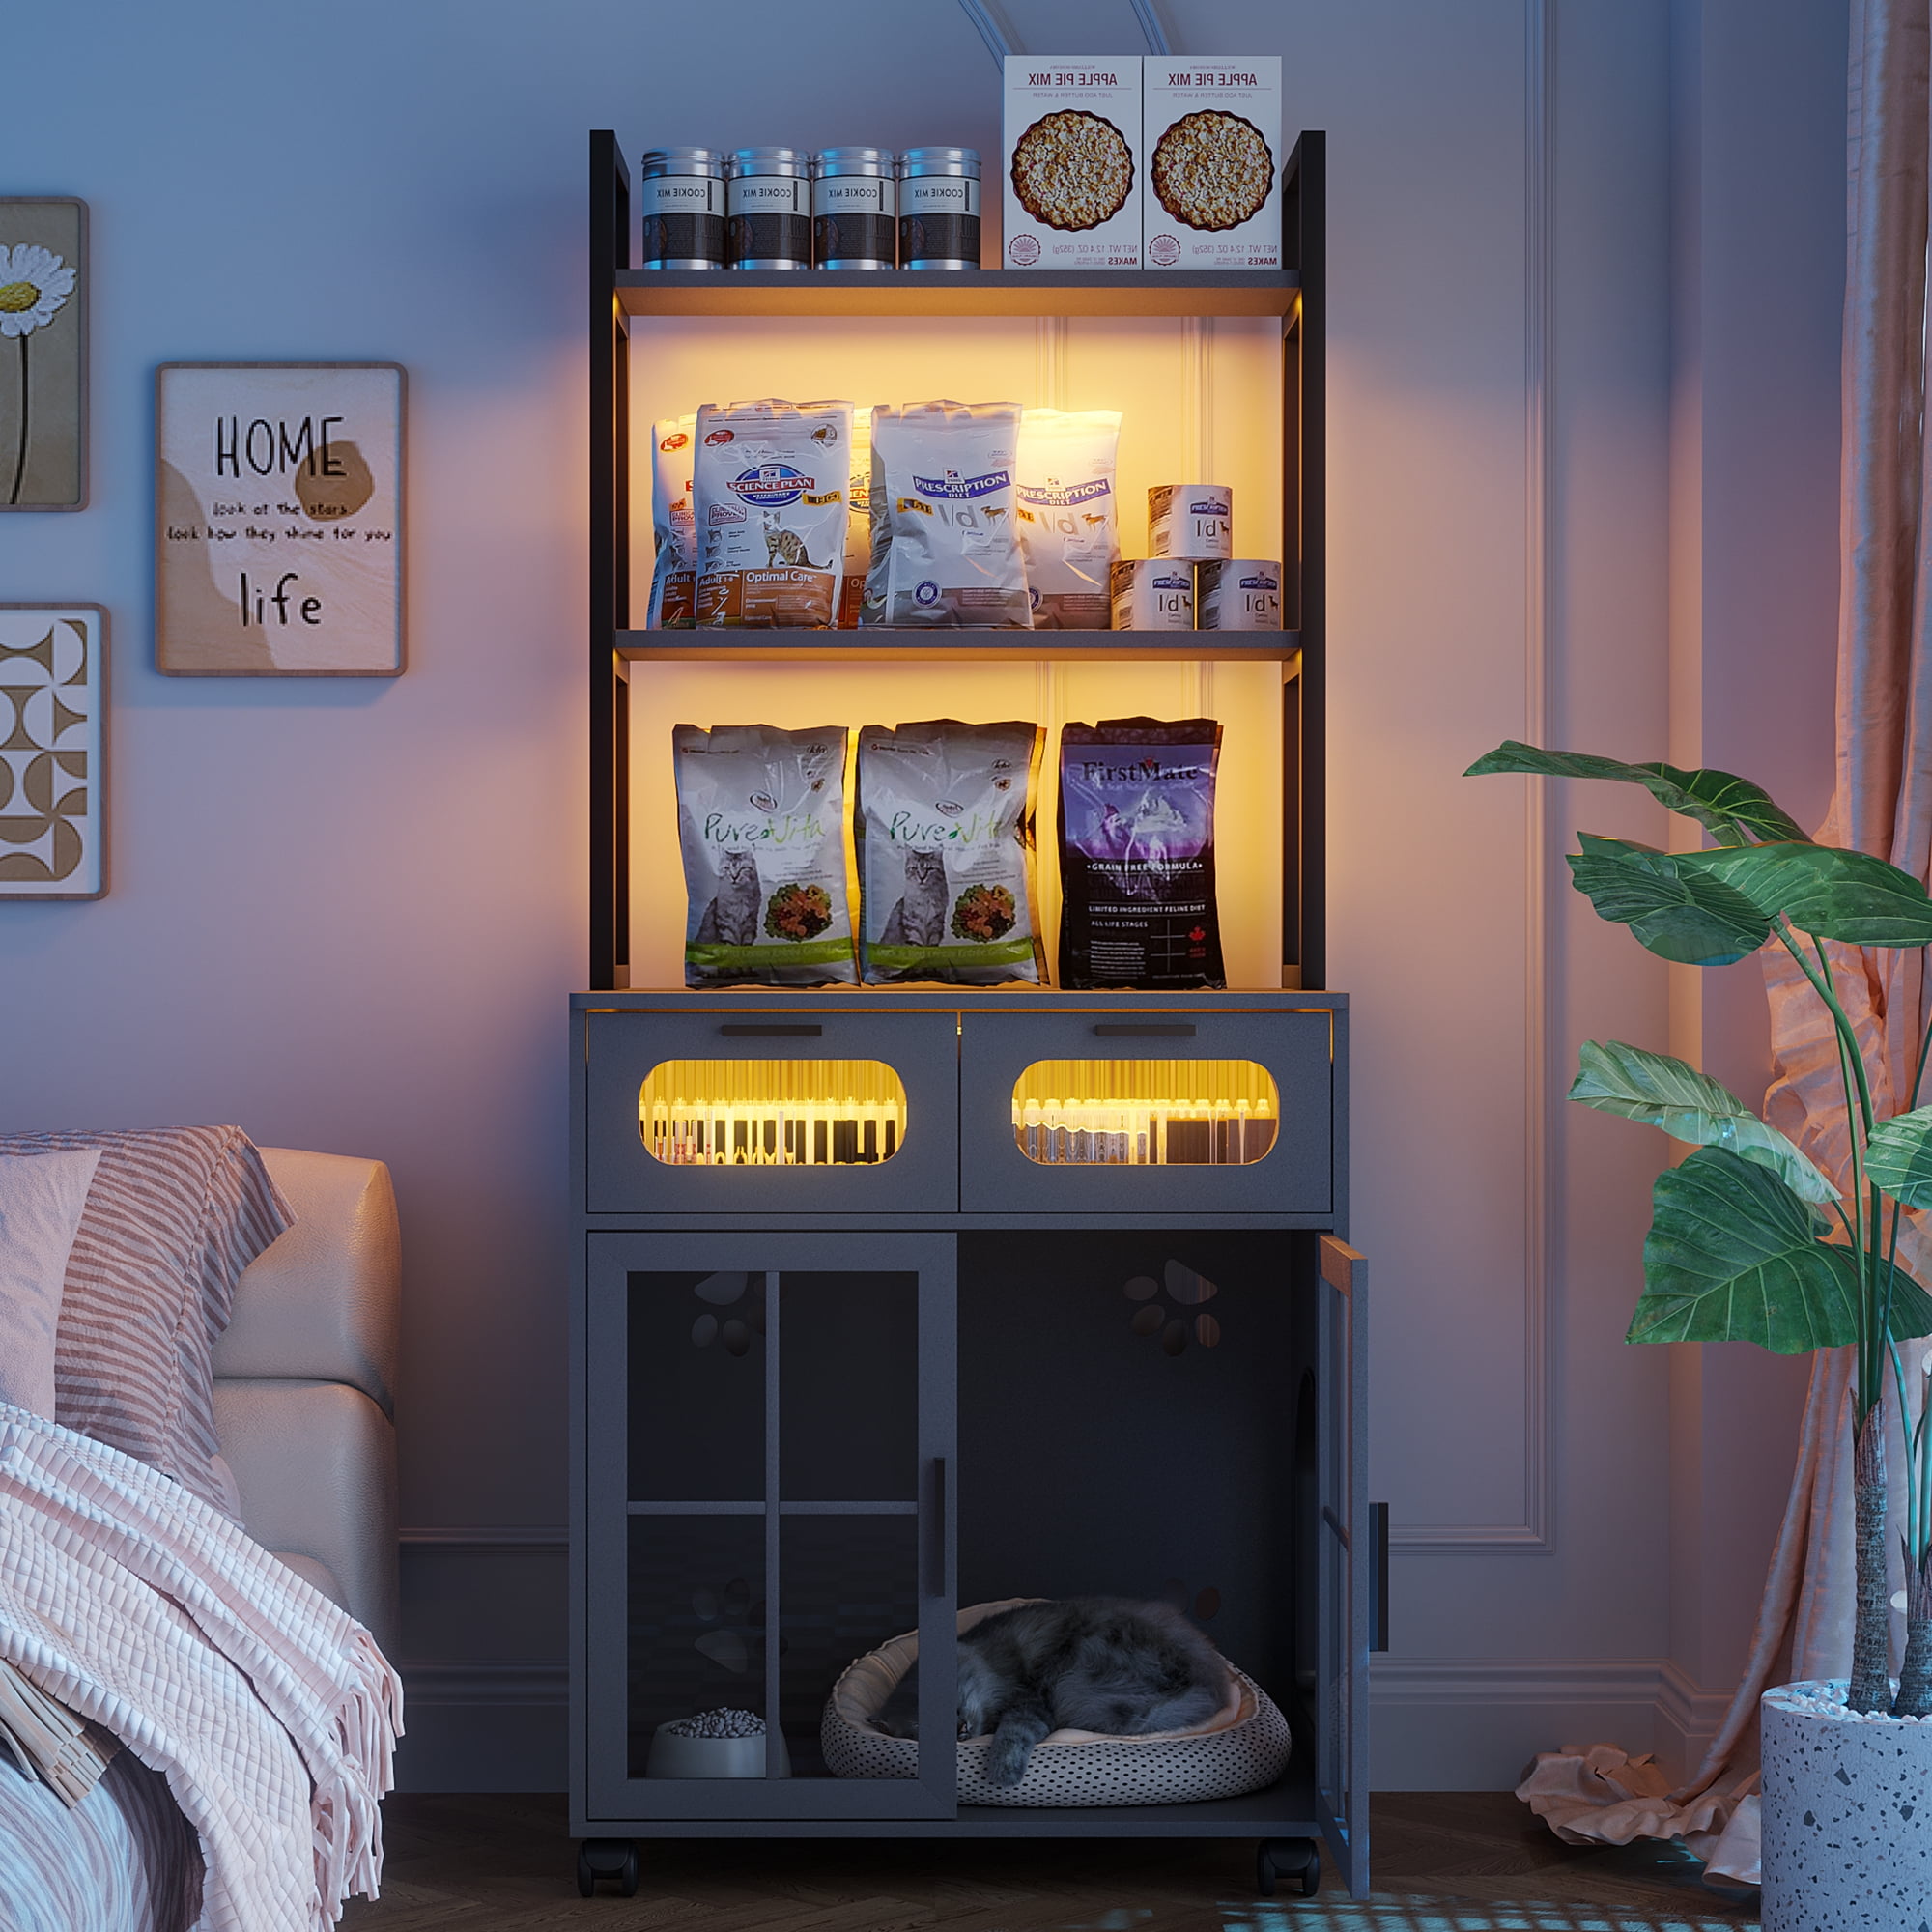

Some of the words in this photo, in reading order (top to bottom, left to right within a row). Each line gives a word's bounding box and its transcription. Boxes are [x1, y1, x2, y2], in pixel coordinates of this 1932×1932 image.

[217, 414, 348, 478] HOME
[730, 481, 780, 492] SCIENCE
[781, 478, 812, 490] PLAN
[915, 474, 1007, 493] PRESCRIPTION
[1016, 481, 1107, 500] PRESCRIPTION
[666, 573, 690, 586] Adult
[699, 576, 723, 586] Adult
[746, 571, 788, 584] Optimal
[241, 572, 322, 627] life
[1082, 761, 1199, 781] FirstMate
[1092, 862, 1122, 871] GRAIN
